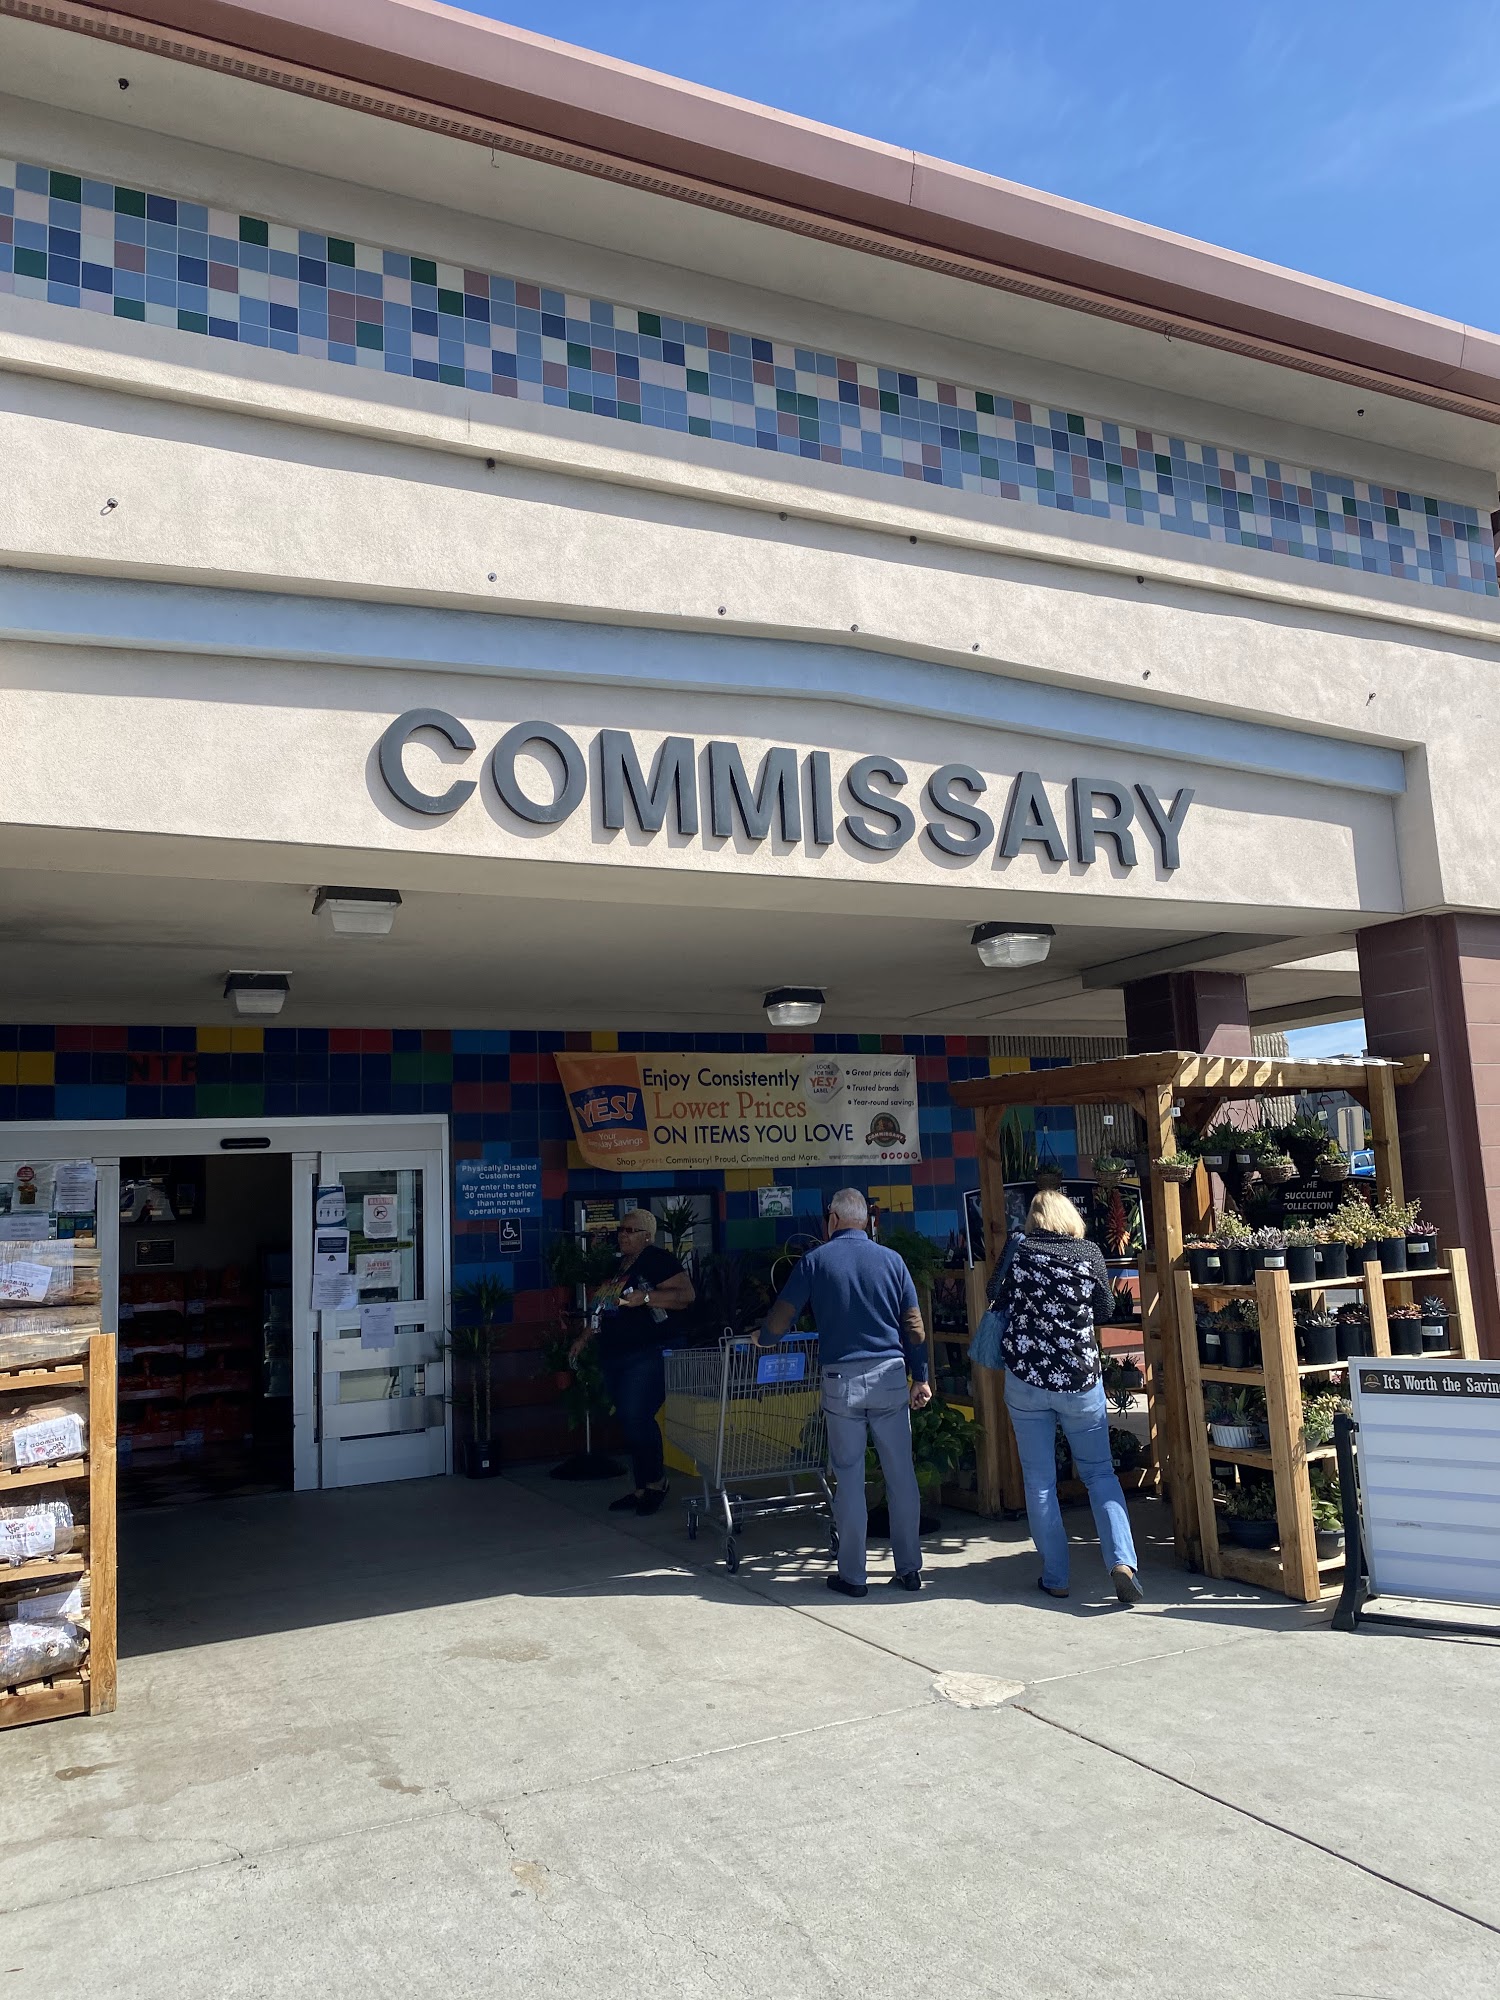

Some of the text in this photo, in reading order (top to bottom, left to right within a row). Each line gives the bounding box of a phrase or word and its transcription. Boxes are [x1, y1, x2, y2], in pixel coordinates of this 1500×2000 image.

[378, 707, 1194, 870] COMMISSARY
[873, 1069, 890, 1077] prices
[894, 1069, 910, 1078] daily
[643, 1068, 800, 1091] Enjoy Consistently
[810, 1077, 837, 1088] YES!
[653, 1091, 807, 1120] Lower Prices
[890, 1099, 914, 1107] savings
[576, 1092, 637, 1128] YES!
[654, 1124, 853, 1144] ON ITEMS YOU LOVE
[614, 1137, 643, 1147] Savings
[616, 1158, 636, 1166] Shop
[666, 1156, 712, 1165] Commissary!
[715, 1155, 738, 1163] Proud,
[741, 1154, 779, 1162] Committed
[782, 1154, 796, 1162] and
[462, 1164, 501, 1173] Physically
[462, 1184, 478, 1192] May
[1285, 1191, 1333, 1200] SUCCULENT
[469, 1208, 506, 1216] operating
[1383, 1374, 1400, 1389] It's
[1403, 1375, 1438, 1391] Worth
[1442, 1377, 1461, 1392] the
